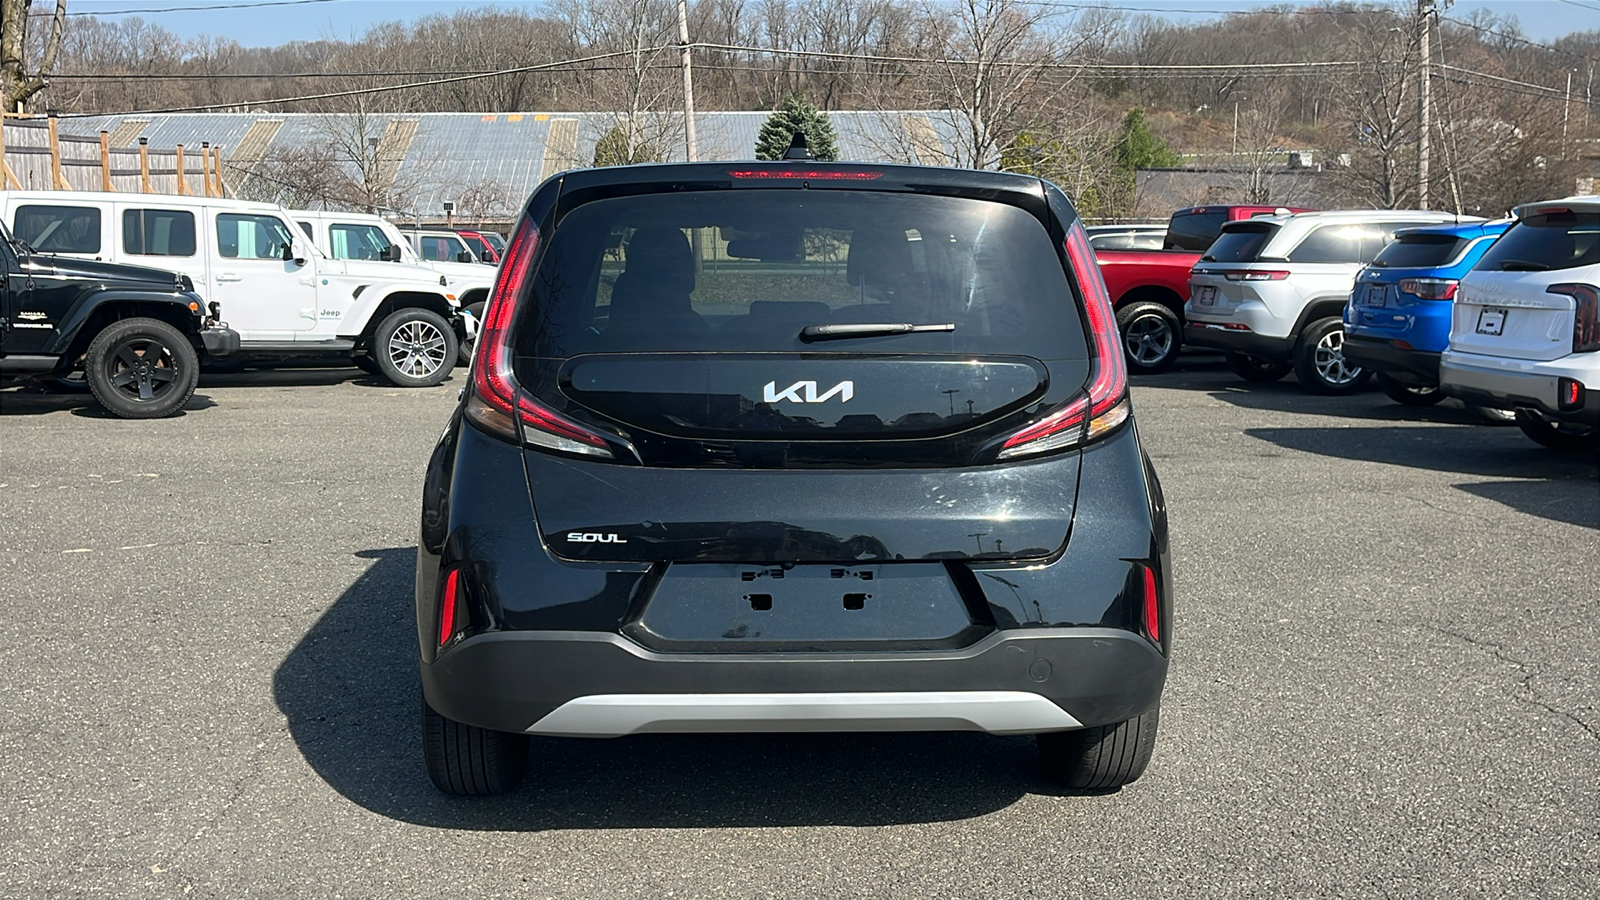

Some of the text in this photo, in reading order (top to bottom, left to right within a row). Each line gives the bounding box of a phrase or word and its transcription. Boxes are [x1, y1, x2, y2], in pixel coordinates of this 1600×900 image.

[320, 309, 341, 317] Jeep
[763, 380, 854, 403] KIA
[567, 532, 628, 543] SOUL
